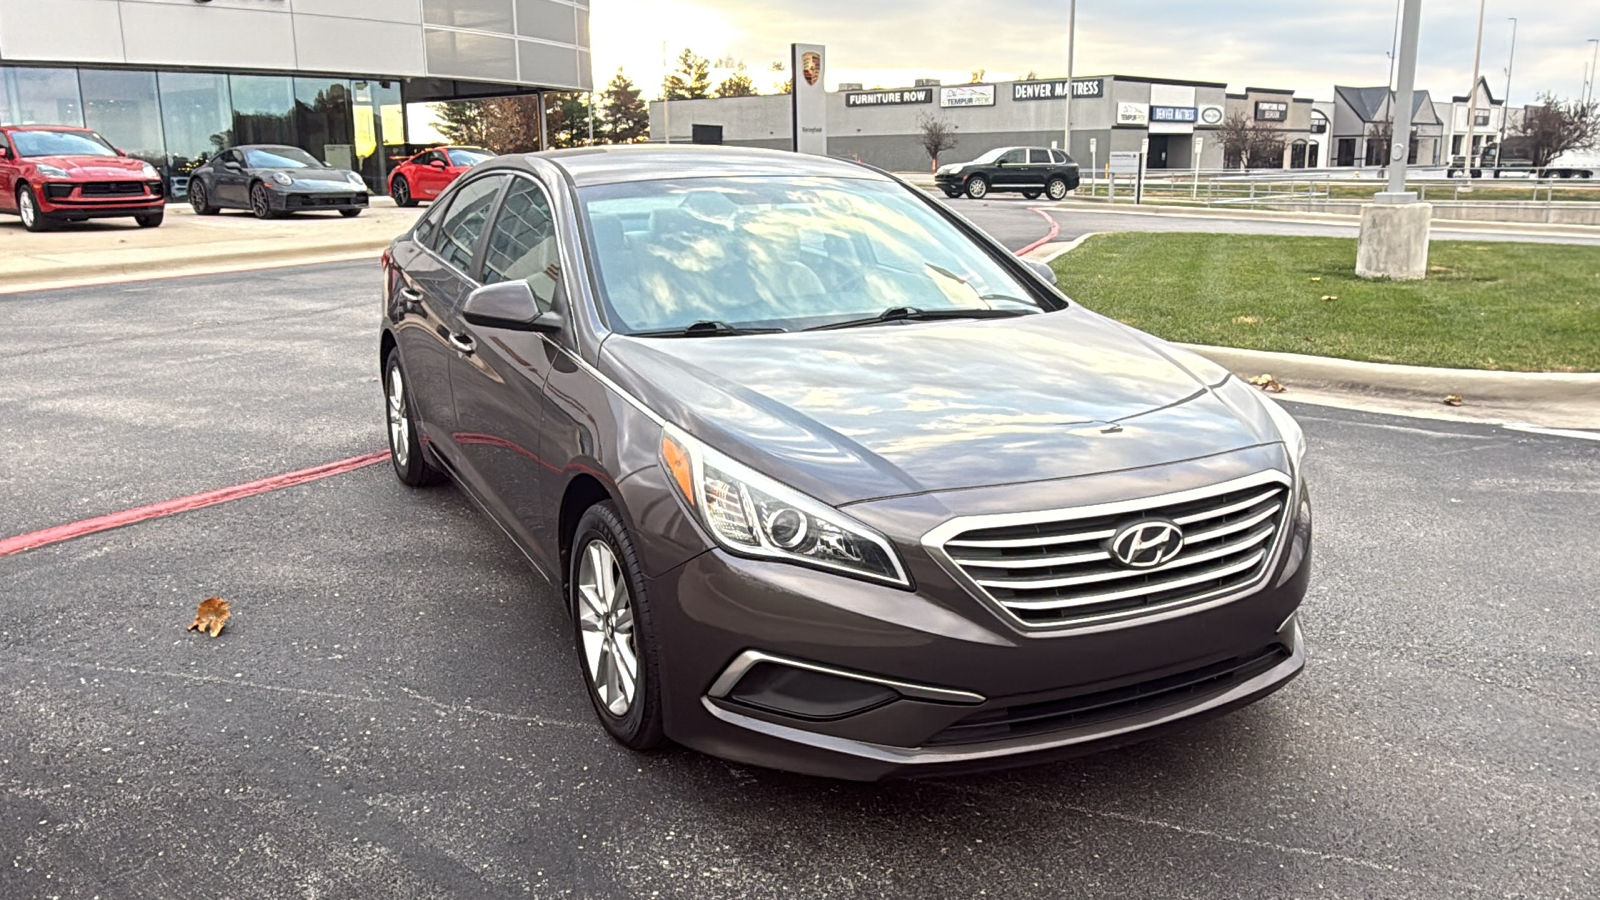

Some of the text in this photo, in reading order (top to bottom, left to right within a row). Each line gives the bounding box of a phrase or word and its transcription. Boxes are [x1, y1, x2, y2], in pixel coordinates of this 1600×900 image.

[1015, 81, 1098, 98] DENVER MATRESS
[849, 91, 926, 105] FURNITURE ROW
[947, 98, 973, 106] TEMPUR
